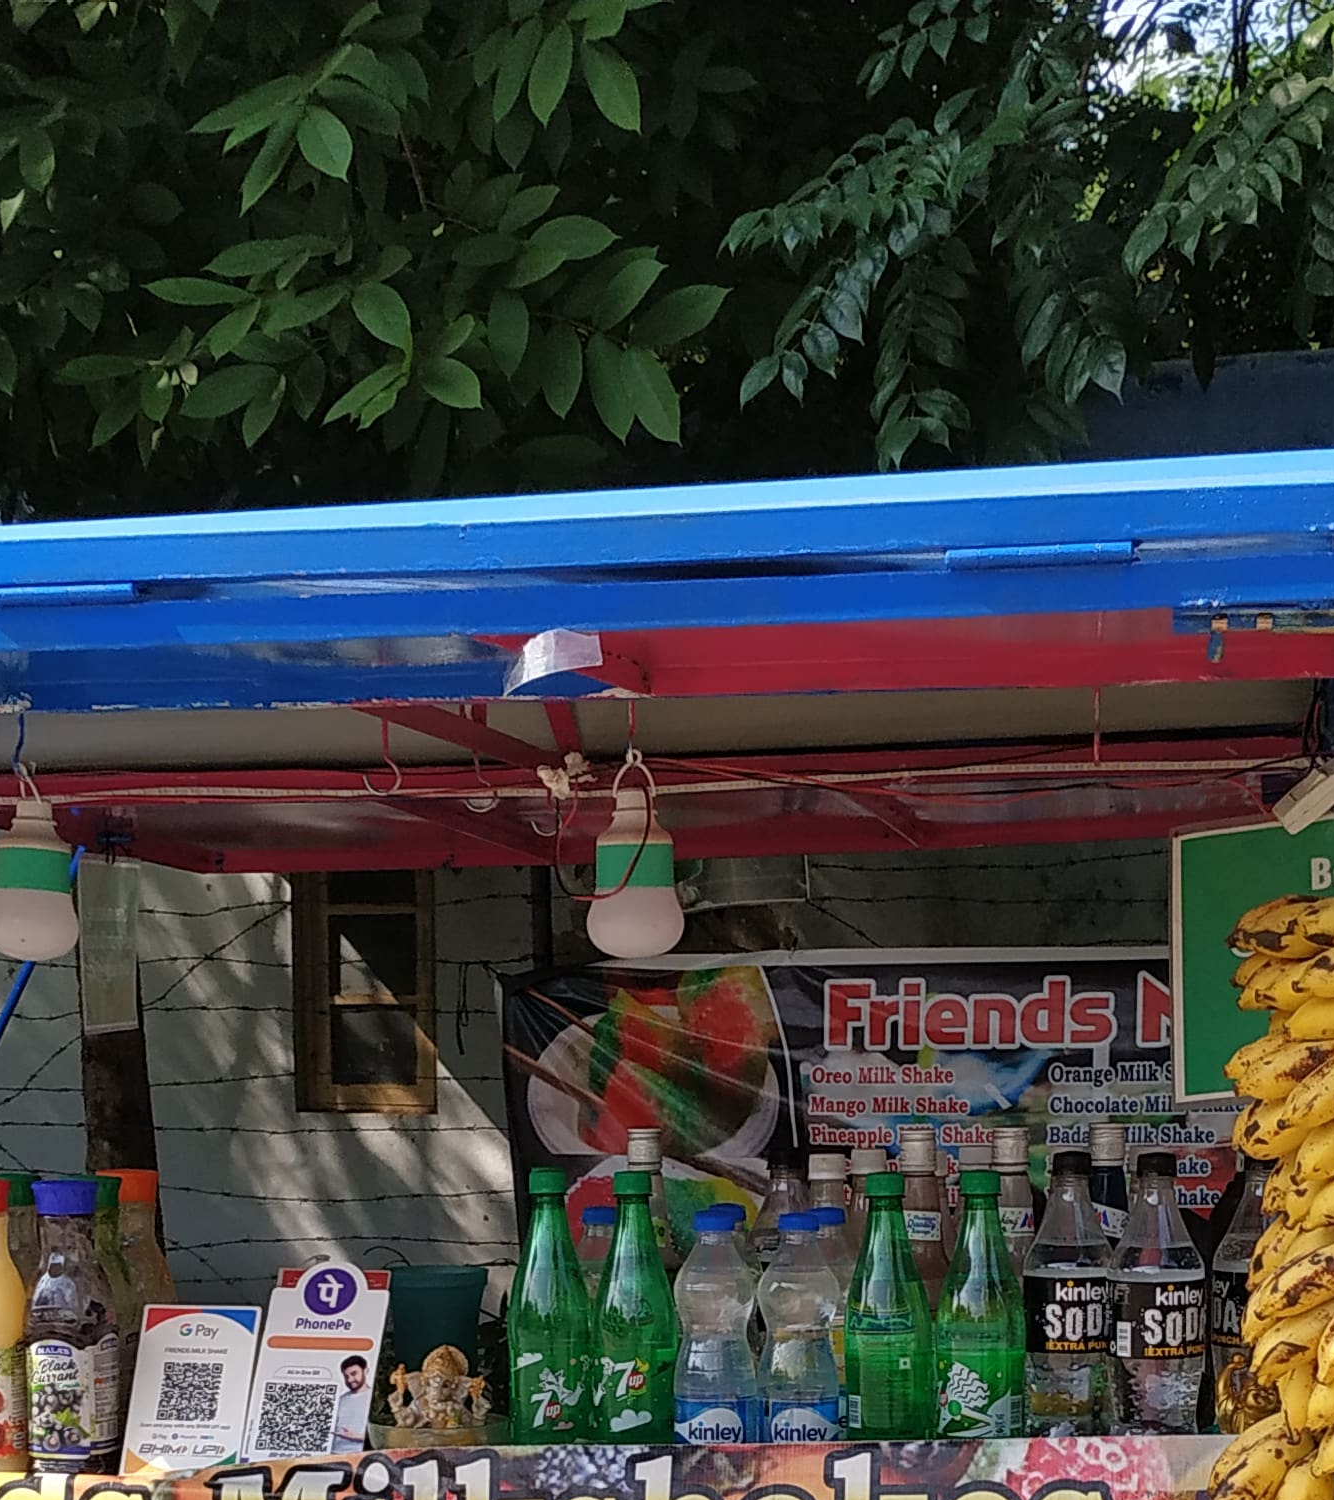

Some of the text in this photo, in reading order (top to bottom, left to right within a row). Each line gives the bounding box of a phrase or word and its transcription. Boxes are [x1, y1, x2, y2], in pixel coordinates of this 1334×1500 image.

[827, 978, 1114, 1046] Friends
[811, 1066, 954, 1085] Oreo Milk Shake
[1050, 1064, 1114, 1087] Orange
[1119, 1064, 1162, 1083] Milk
[810, 1096, 969, 1117] Mango Milk Shake
[1049, 1096, 1139, 1115] Chocolate
[1143, 1096, 1174, 1114] Mil
[810, 1126, 994, 1149] Pineapple Shake
[1048, 1126, 1090, 1145] Bada
[1159, 1127, 1216, 1145] Shake
[1178, 1157, 1210, 1175] ake
[1177, 1186, 1221, 1206] hake
[1055, 1280, 1108, 1303] kinley
[1155, 1285, 1203, 1306] kinley
[195, 1323, 219, 1339] Pay
[294, 1317, 352, 1331] PhonePe
[39, 1358, 76, 1373] Black
[688, 1422, 743, 1442] kinley
[774, 1422, 828, 1442] kinley
